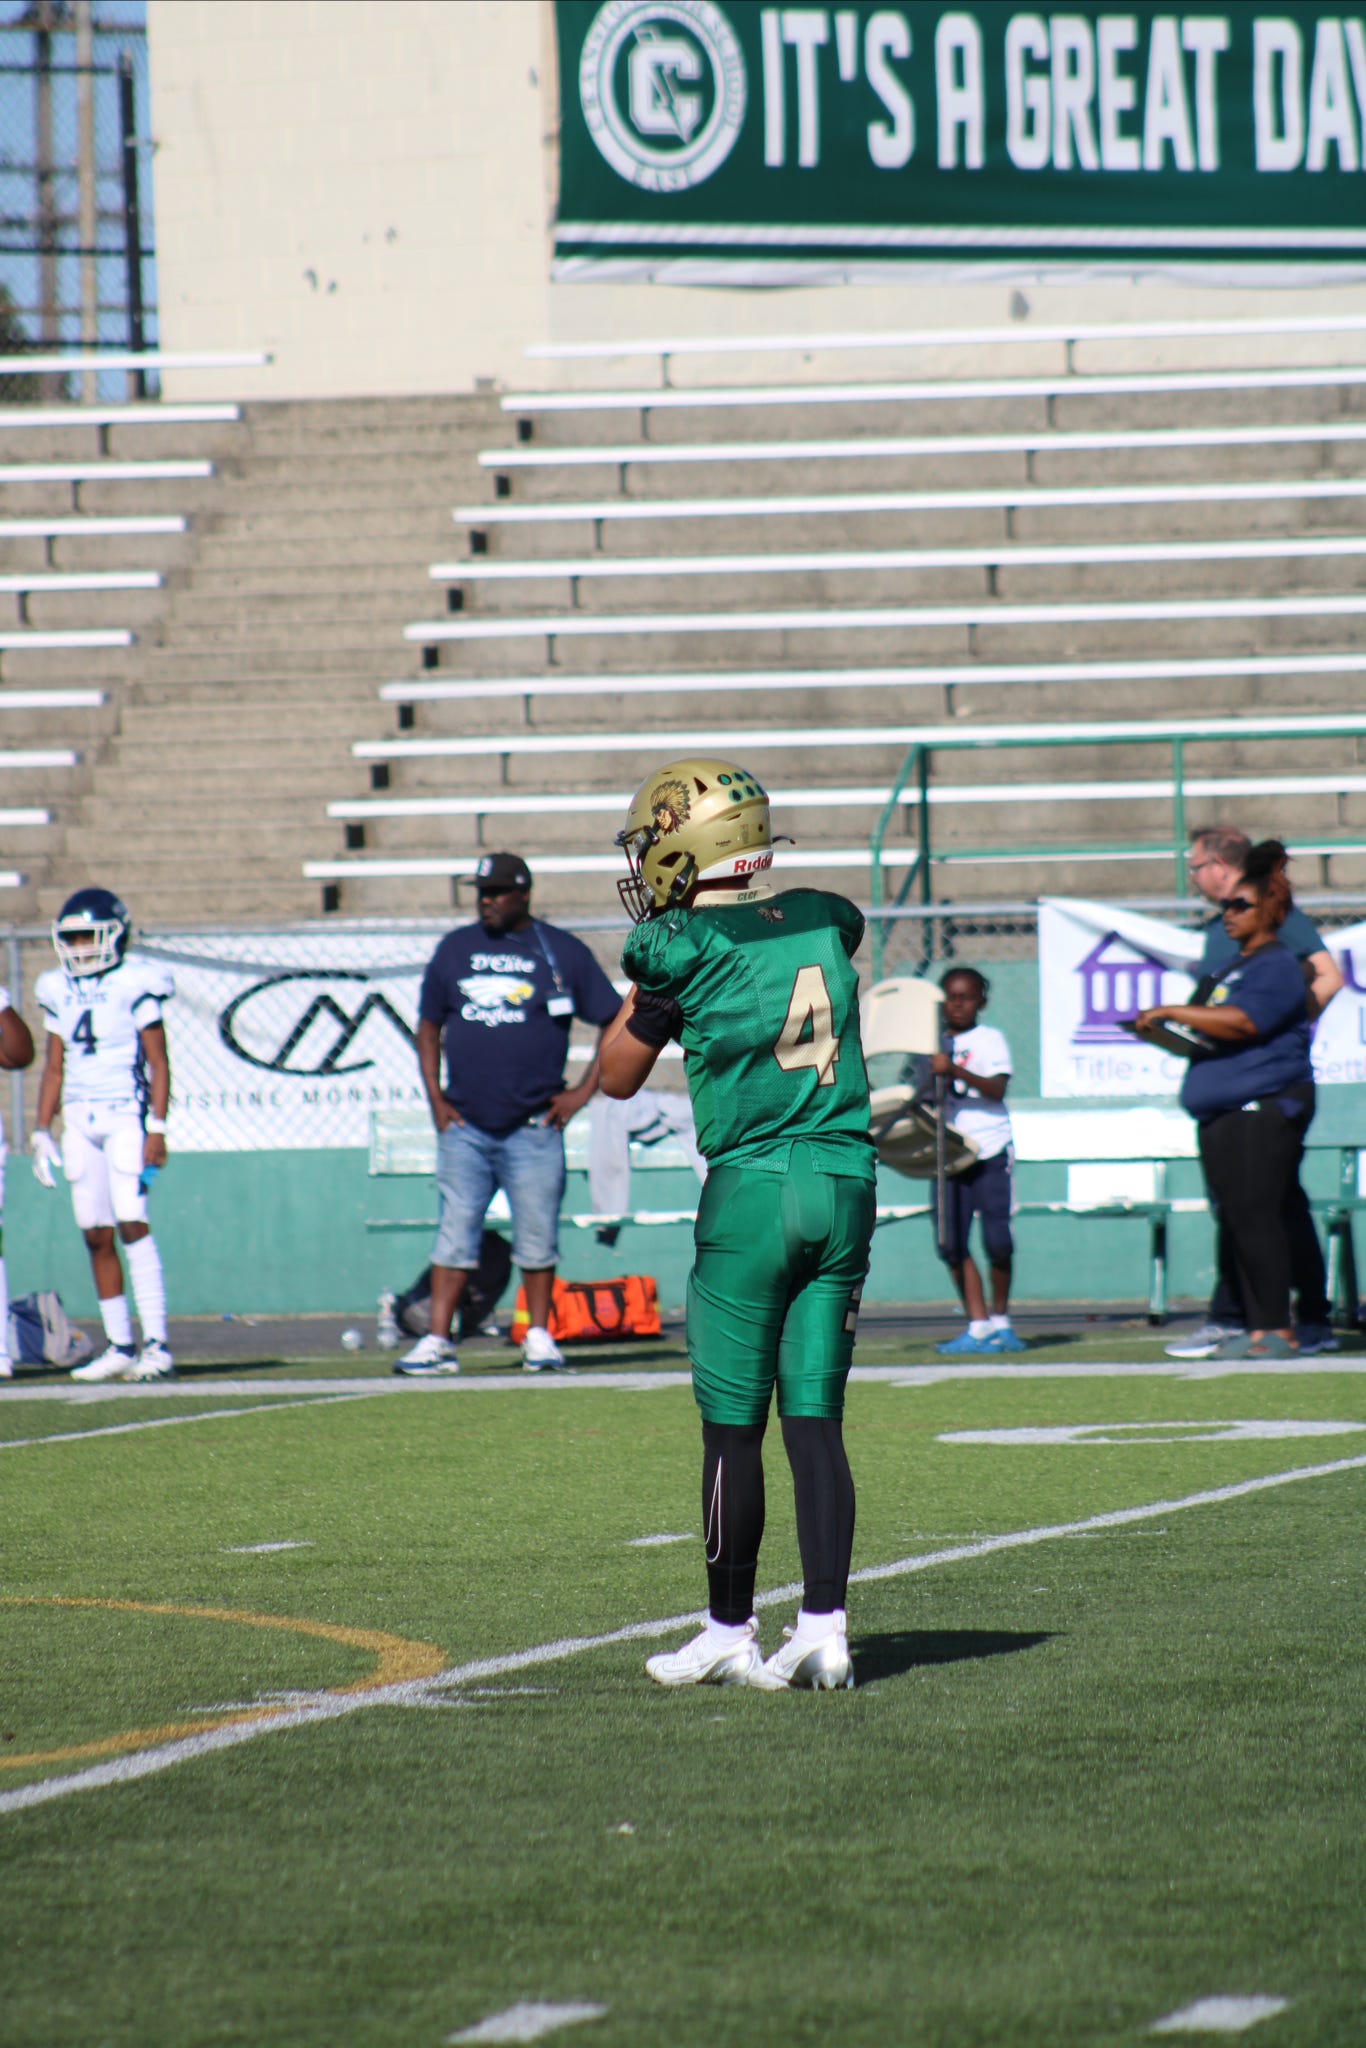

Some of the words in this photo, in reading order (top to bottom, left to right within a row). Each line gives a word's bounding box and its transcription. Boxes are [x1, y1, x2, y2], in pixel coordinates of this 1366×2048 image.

[761, 9, 915, 169] IT'S
[935, 10, 984, 169] A
[1004, 14, 1230, 172] GREAT
[461, 1002, 526, 1028] Eagles
[774, 963, 840, 1088] 4
[72, 1009, 98, 1055] 4
[1070, 1055, 1134, 1081] Title
[1160, 1055, 1186, 1081] C
[1311, 1054, 1366, 1082] Sett
[168, 1089, 284, 1107] ISTINE
[302, 1085, 424, 1106] MONAHA
